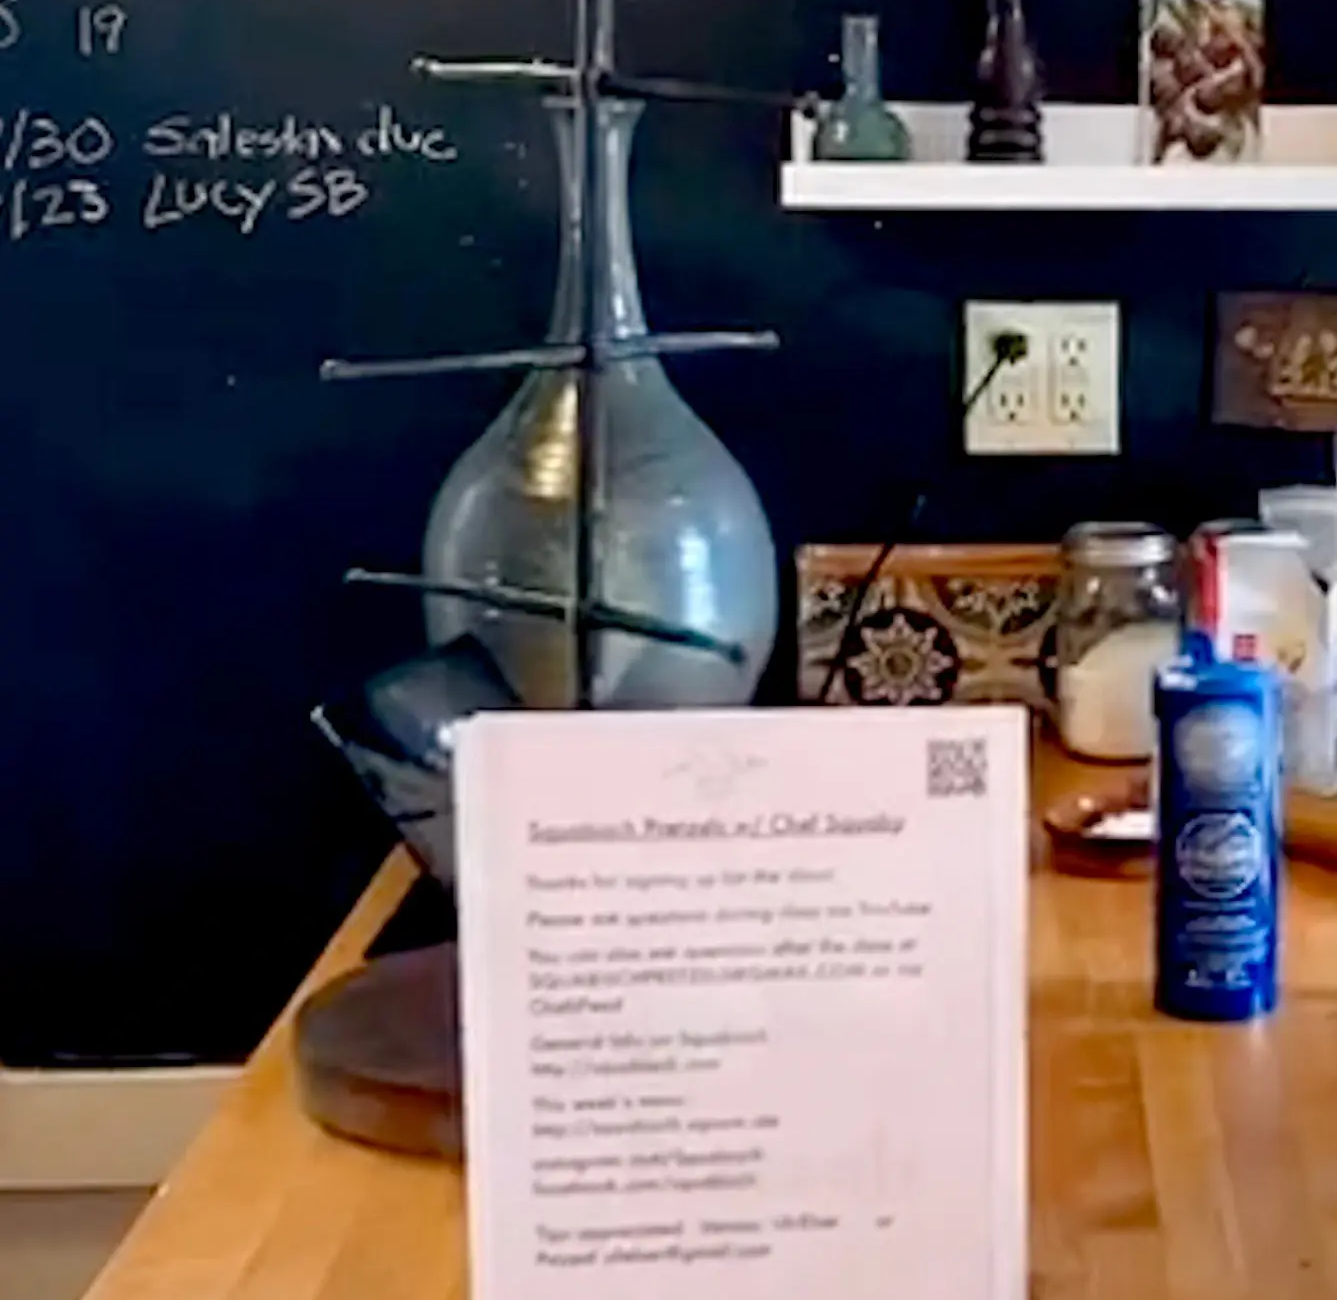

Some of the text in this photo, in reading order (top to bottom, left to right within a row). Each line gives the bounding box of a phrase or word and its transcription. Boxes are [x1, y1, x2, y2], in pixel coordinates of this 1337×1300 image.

[78, 4, 127, 55] 19
[0, 108, 114, 169] /30
[0, 179, 108, 239] /23
[286, 166, 368, 219] SB
